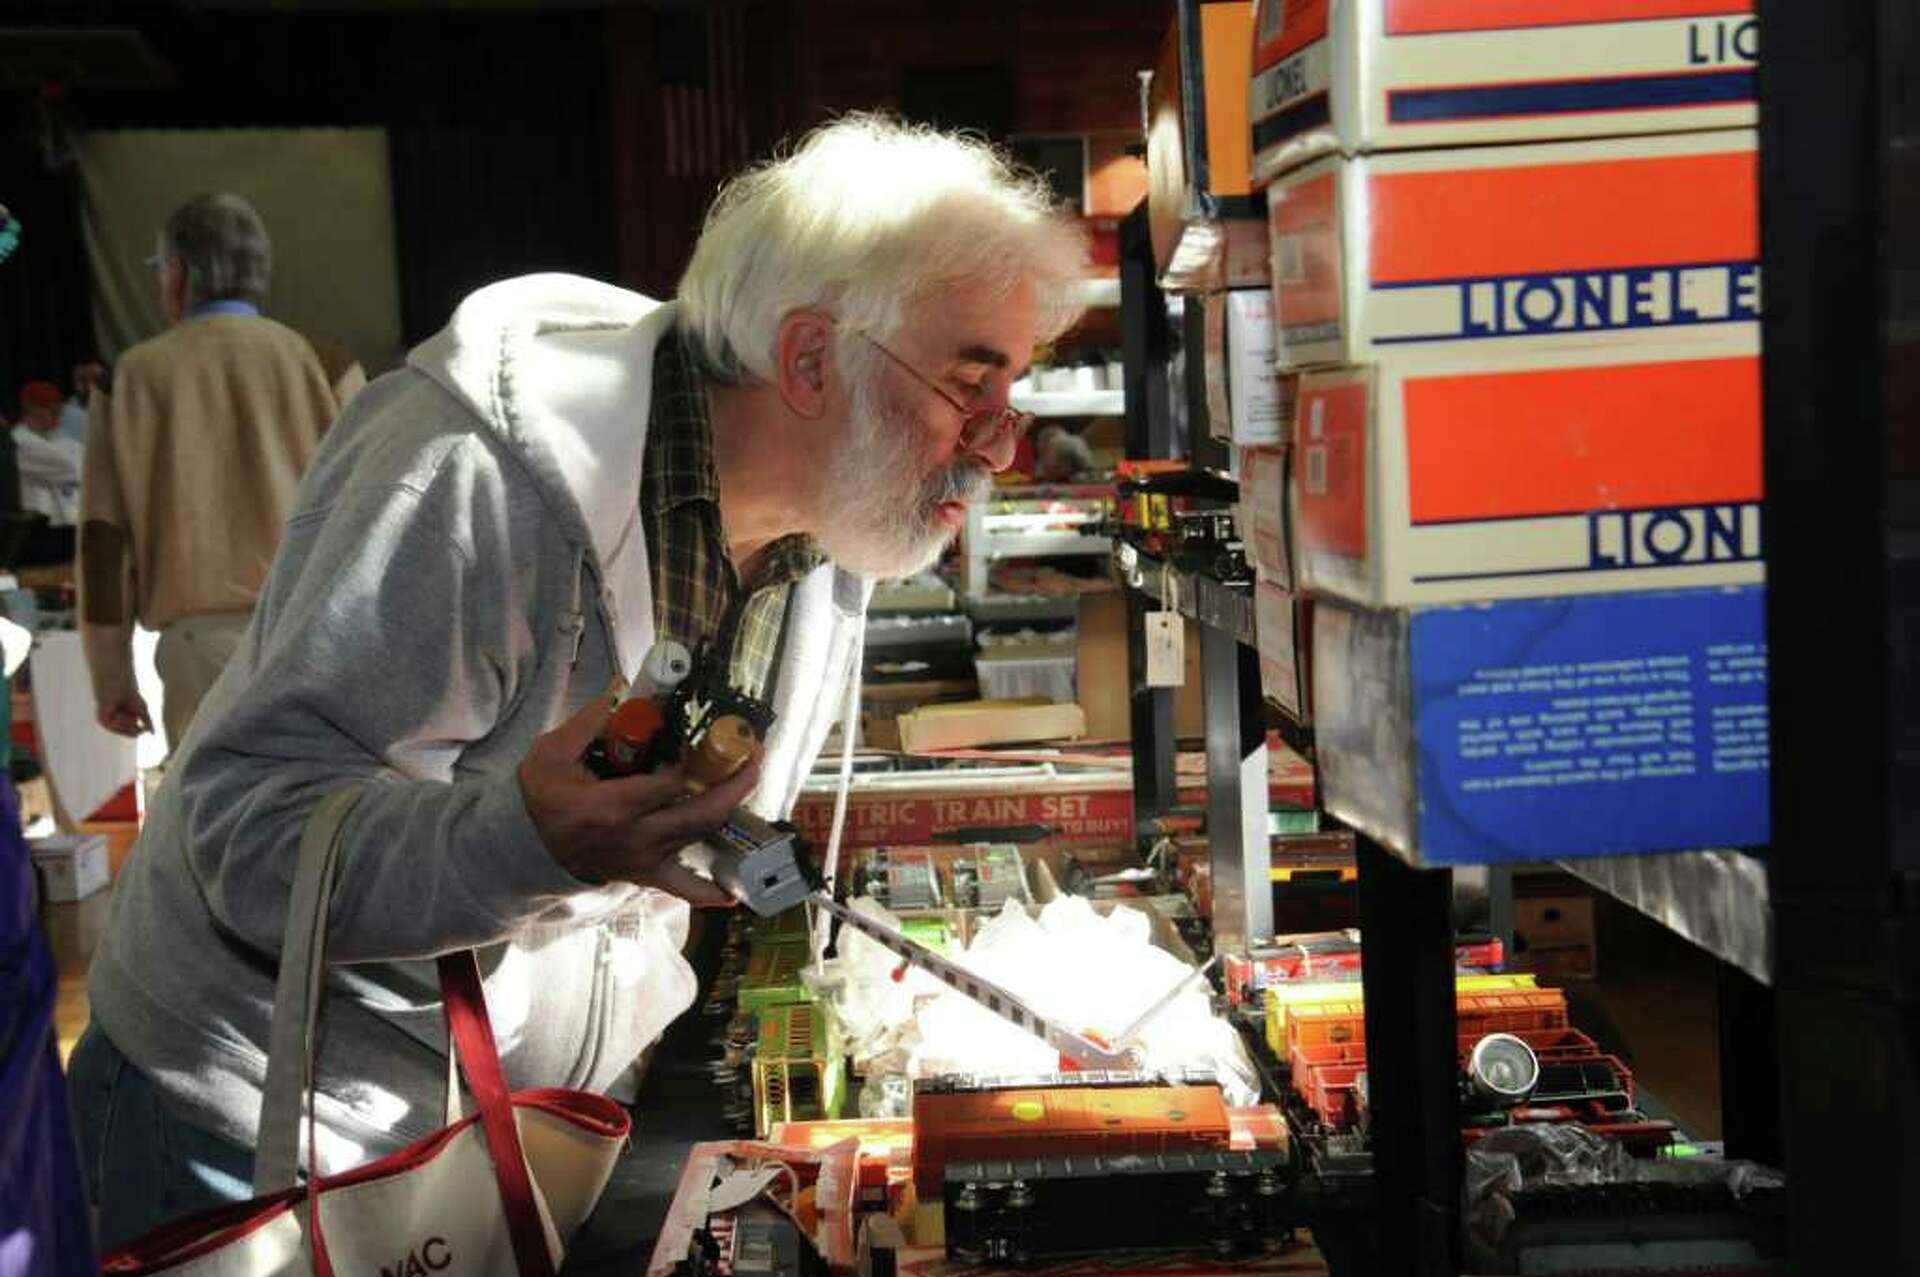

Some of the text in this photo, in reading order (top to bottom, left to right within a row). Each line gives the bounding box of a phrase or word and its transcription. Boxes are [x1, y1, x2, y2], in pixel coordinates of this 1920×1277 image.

[1689, 21, 1759, 64] LIO
[1461, 268, 1698, 337] LIONEL
[1589, 506, 1741, 569] LION
[795, 795, 1091, 827] LETRIC TRAIN SET
